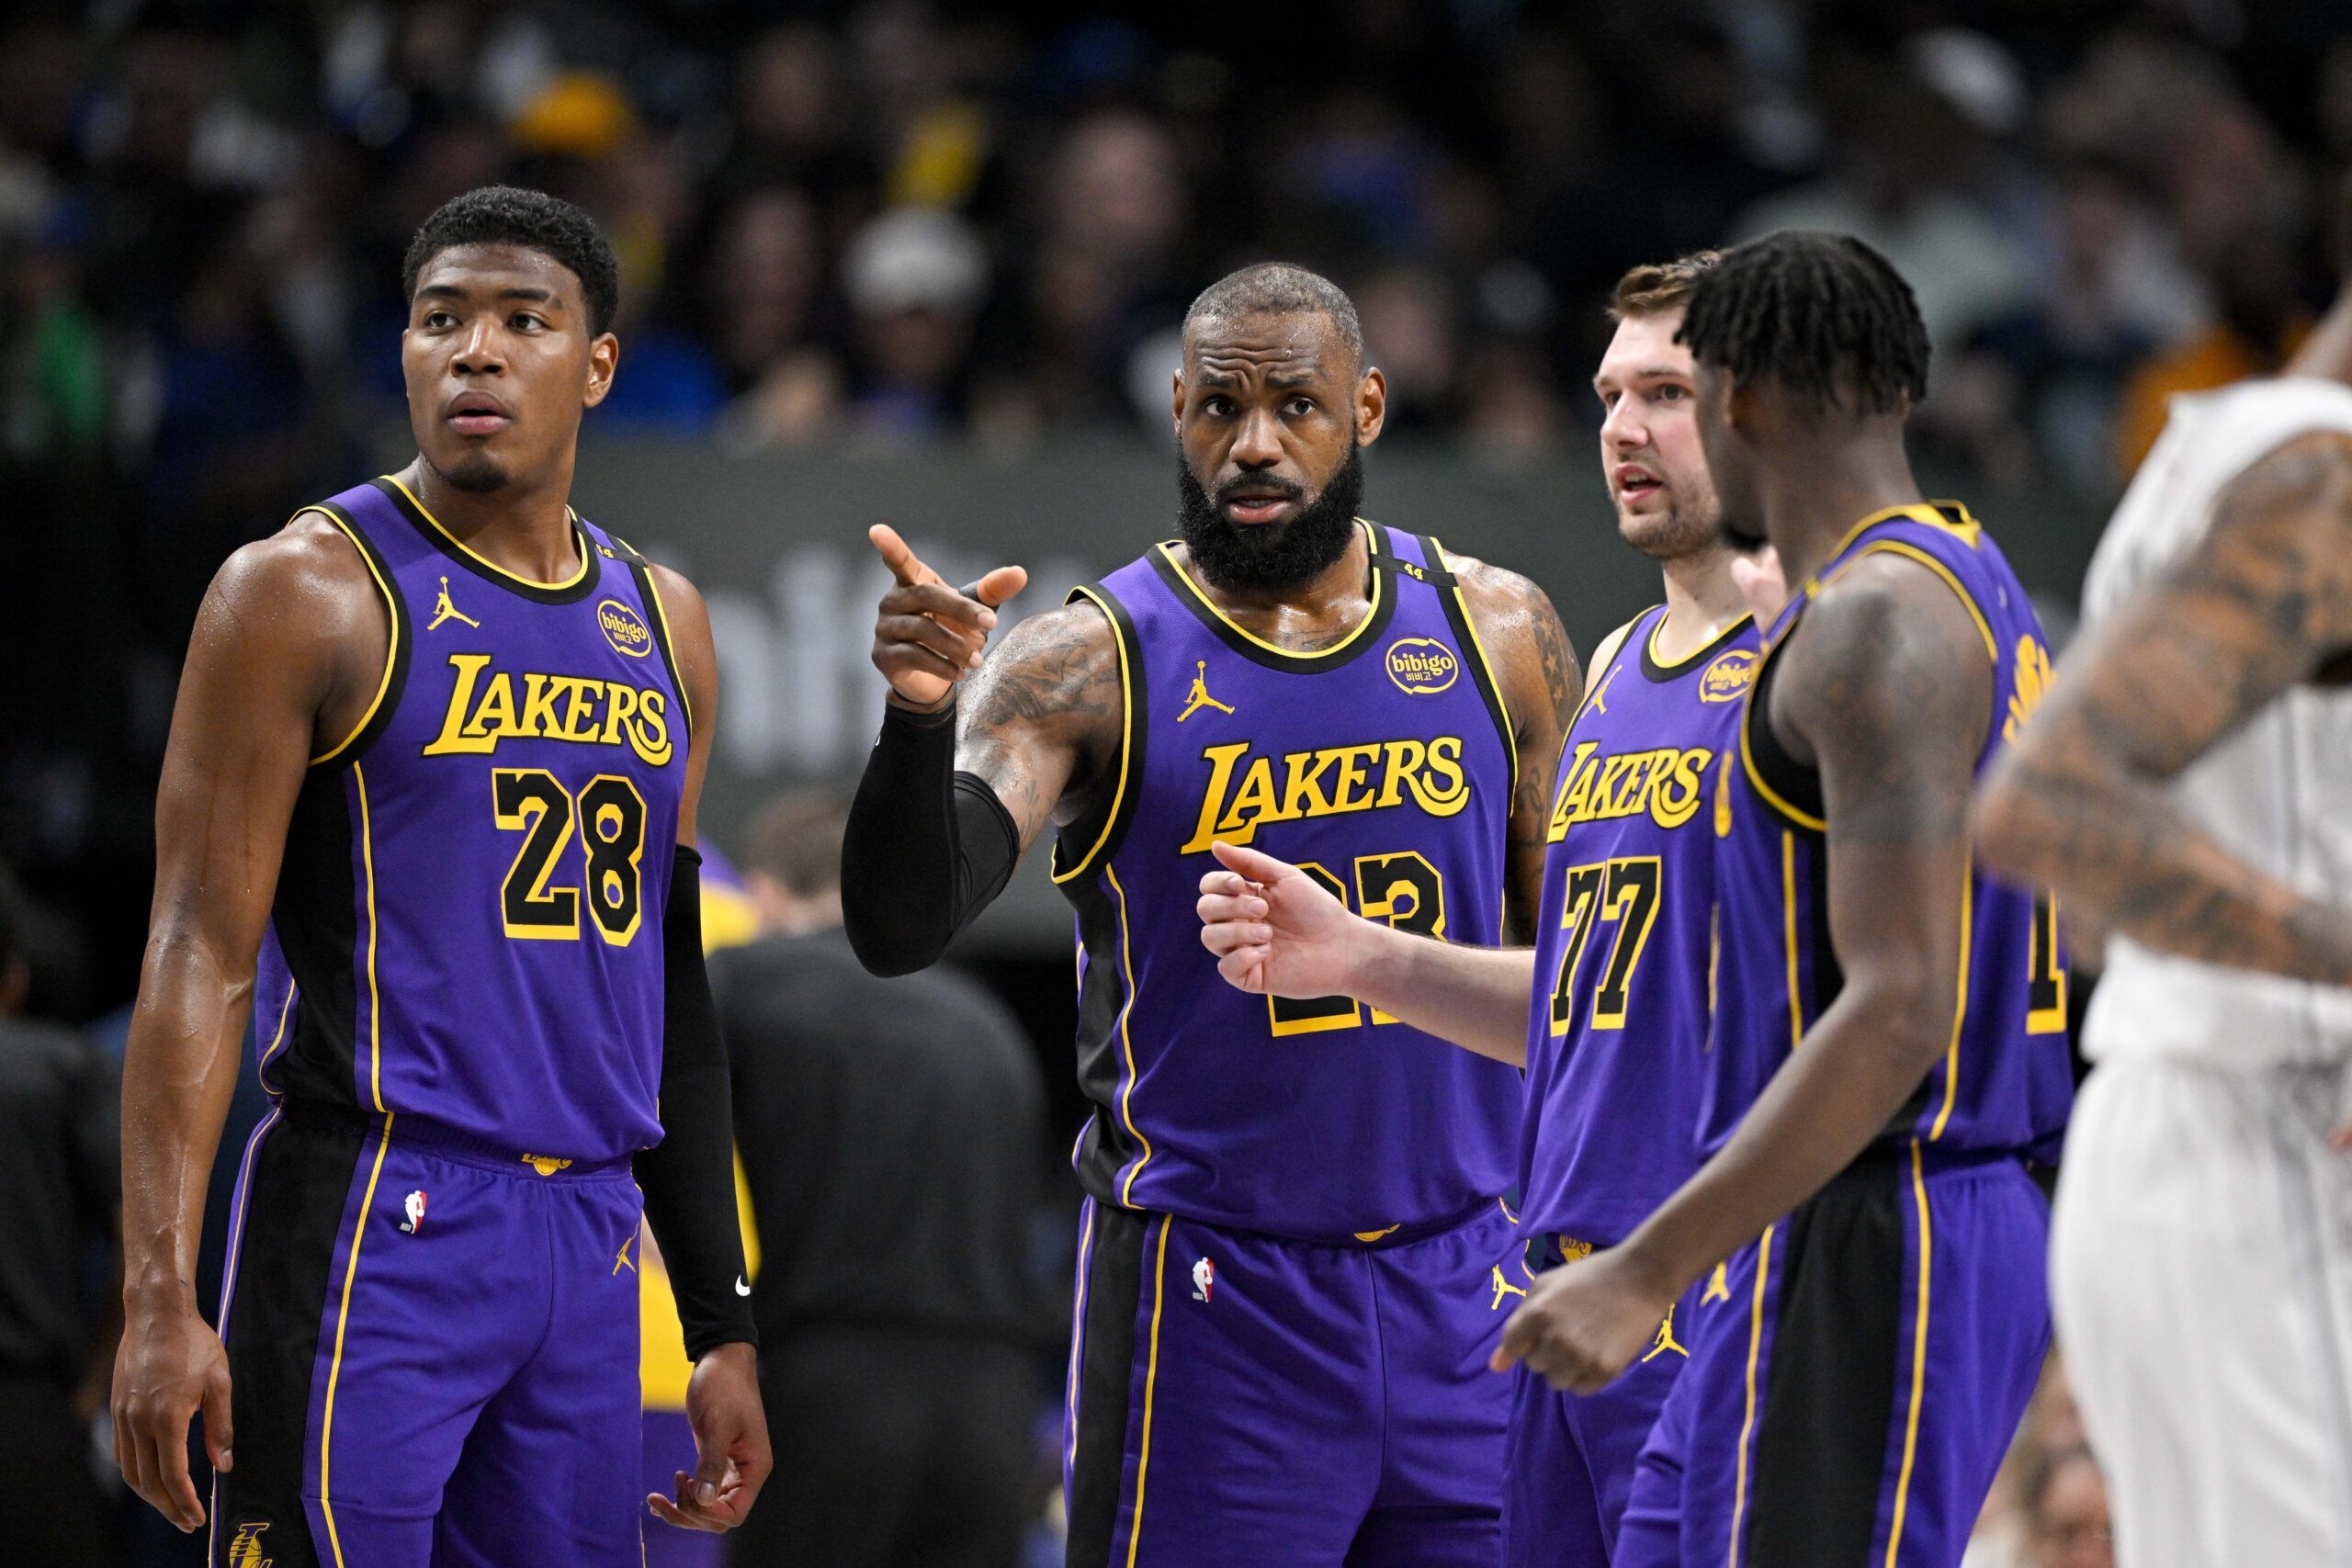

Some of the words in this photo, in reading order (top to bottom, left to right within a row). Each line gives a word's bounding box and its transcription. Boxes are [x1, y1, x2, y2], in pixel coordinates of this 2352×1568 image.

[1404, 563, 1424, 581] 44
[601, 612, 647, 643] bibigo
[1391, 652, 1453, 676] bibigo
[420, 652, 674, 768] LAKERS
[1406, 672, 1431, 682] 비비고
[1179, 735, 1471, 856] LAKERS
[1546, 746, 1713, 844] LAKERS
[492, 767, 647, 948] 28
[1550, 855, 1662, 1038] 77
